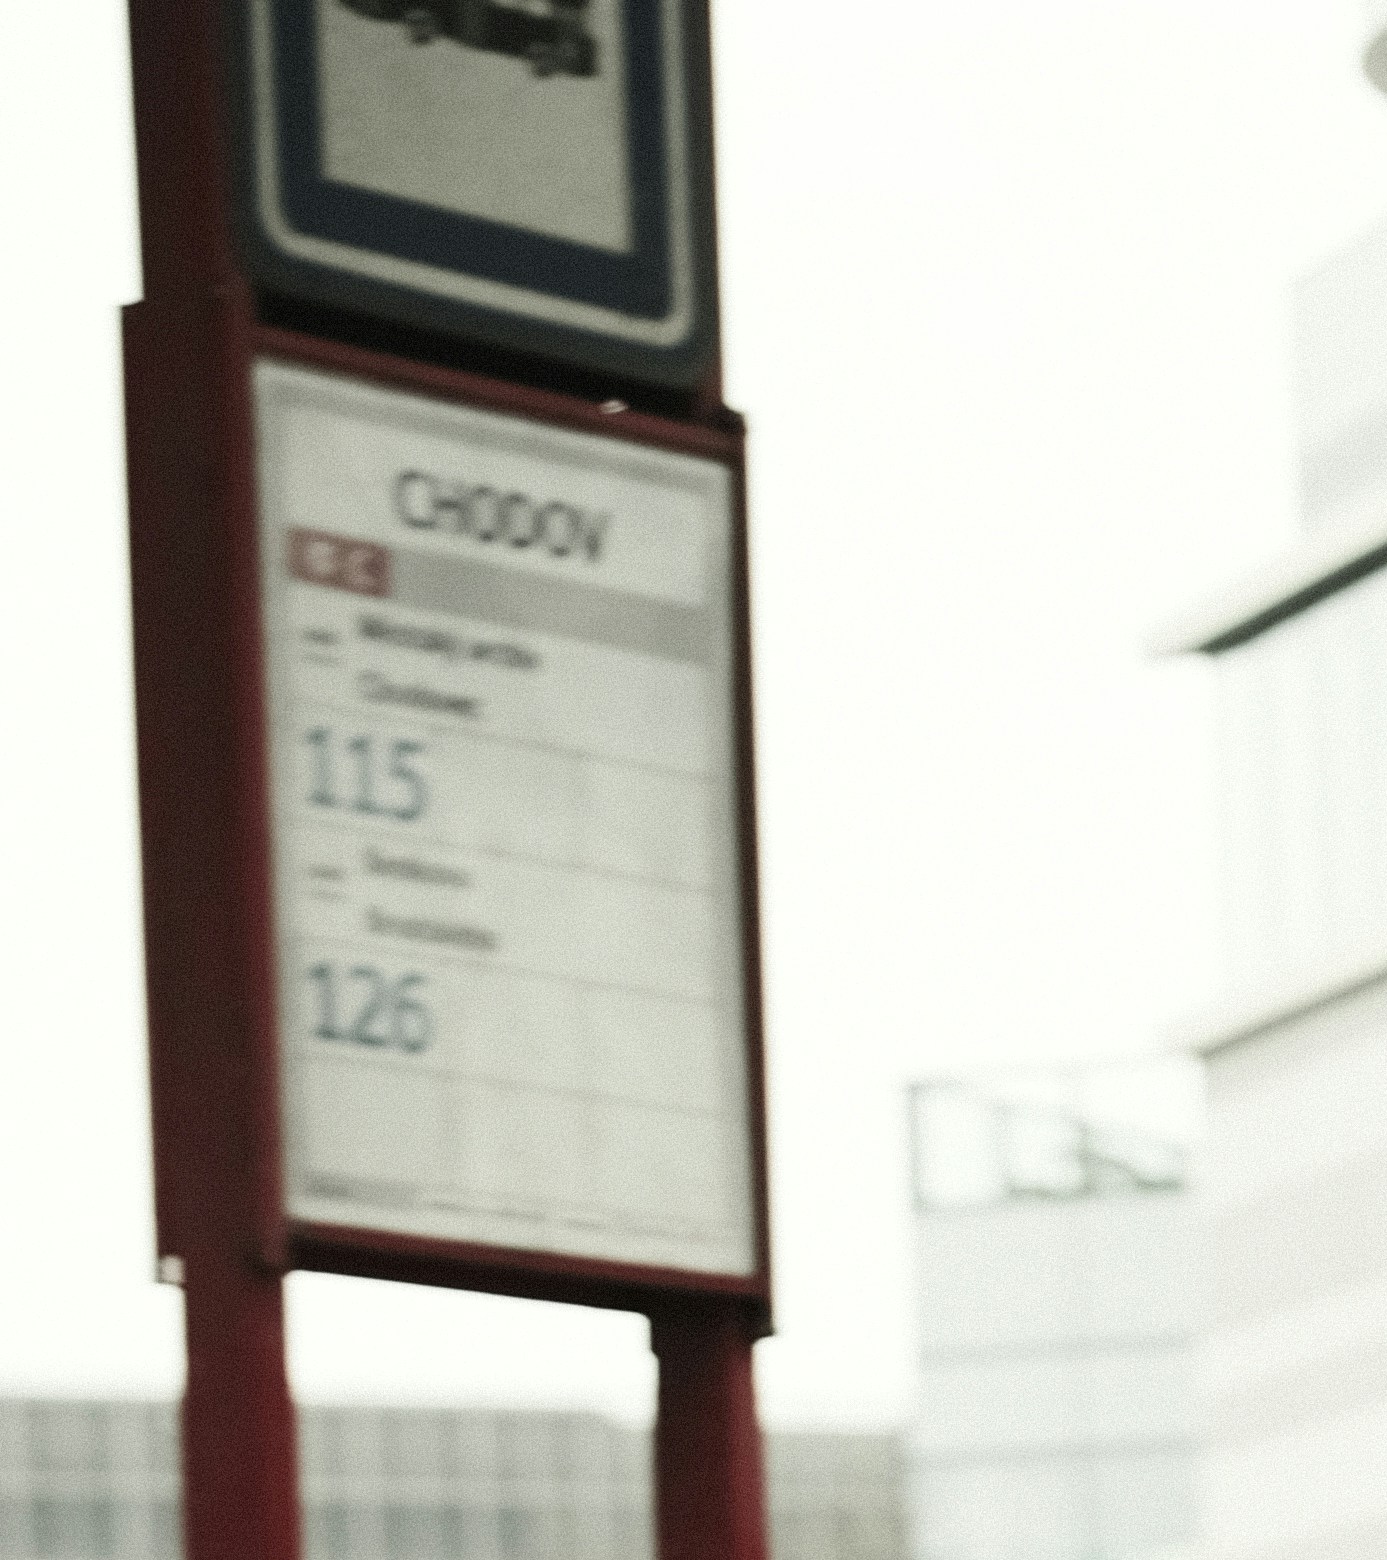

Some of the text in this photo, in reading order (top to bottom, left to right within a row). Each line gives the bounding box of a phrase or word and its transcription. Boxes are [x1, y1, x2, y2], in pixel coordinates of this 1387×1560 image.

[394, 468, 610, 562] CHODOV
[306, 727, 431, 822] 115
[308, 962, 437, 1055] 126
